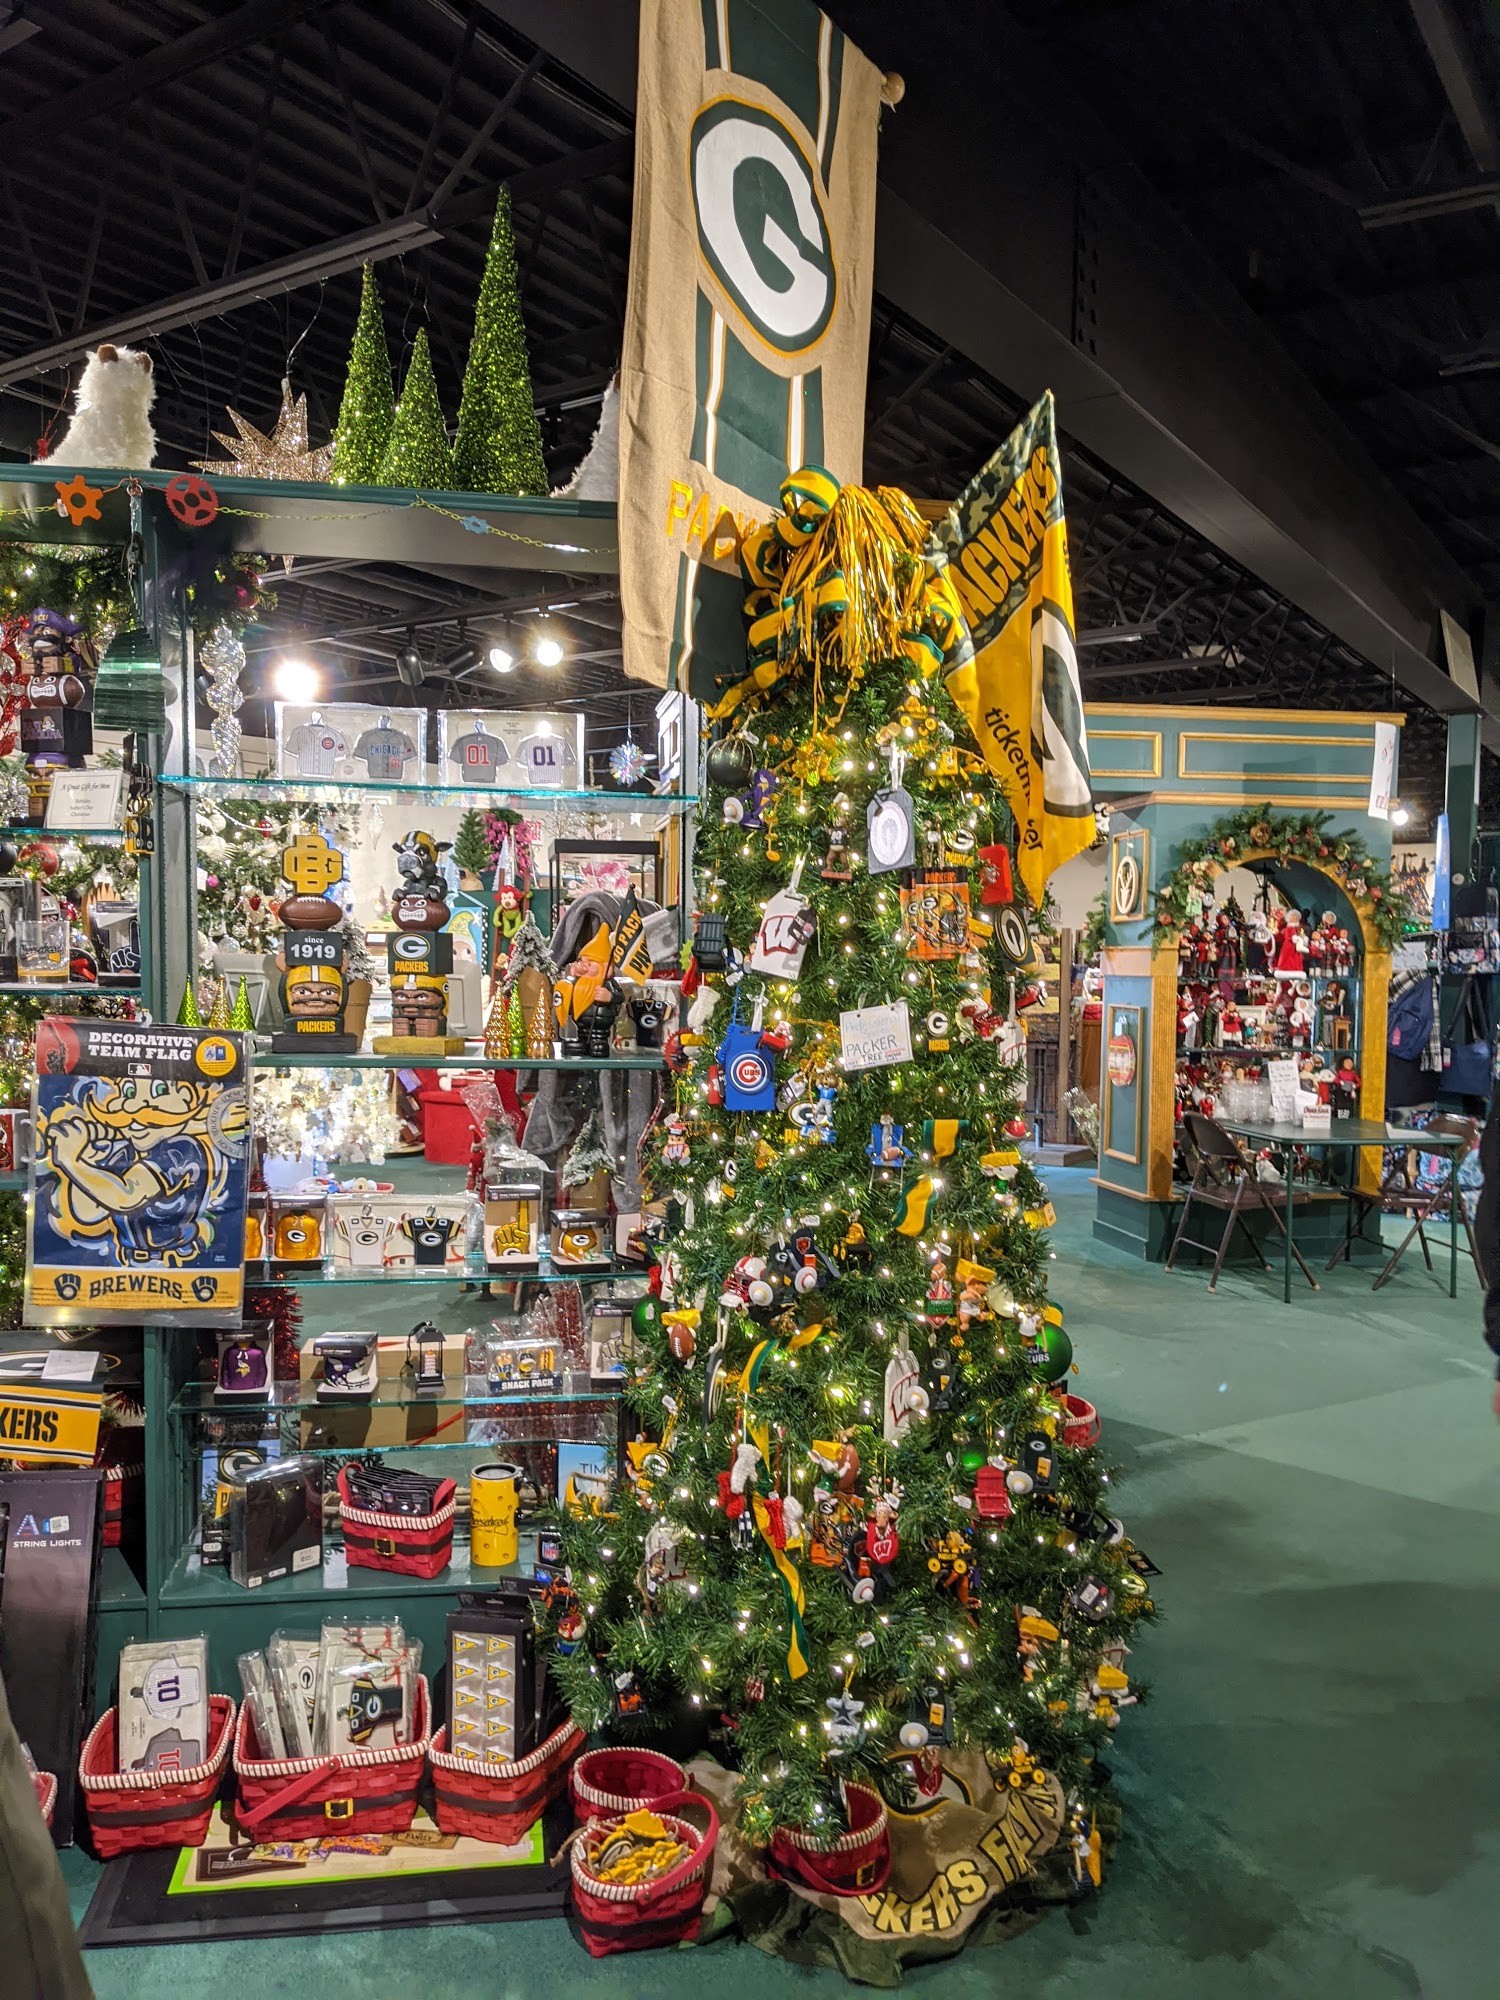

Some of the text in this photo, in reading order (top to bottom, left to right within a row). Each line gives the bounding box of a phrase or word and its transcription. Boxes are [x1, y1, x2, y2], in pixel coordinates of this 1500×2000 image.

[370, 743, 401, 757] CHICAGO
[466, 743, 490, 767] 01
[533, 745, 556, 767] 01
[924, 871, 957, 883] PACKERS
[304, 936, 325, 944] since
[290, 944, 336, 959] 1919
[394, 961, 429, 973] PACKERS
[296, 1021, 336, 1033] PACKERS
[88, 1032, 193, 1048] DECORATIVE
[846, 1034, 898, 1057] PACKER
[88, 1045, 192, 1061] TEAM FLAG
[861, 1051, 884, 1063] TREE
[88, 1274, 184, 1300] BREWERS
[501, 1378, 554, 1390] SNACK PACK
[13, 1539, 82, 1548] STRING LIGHTS
